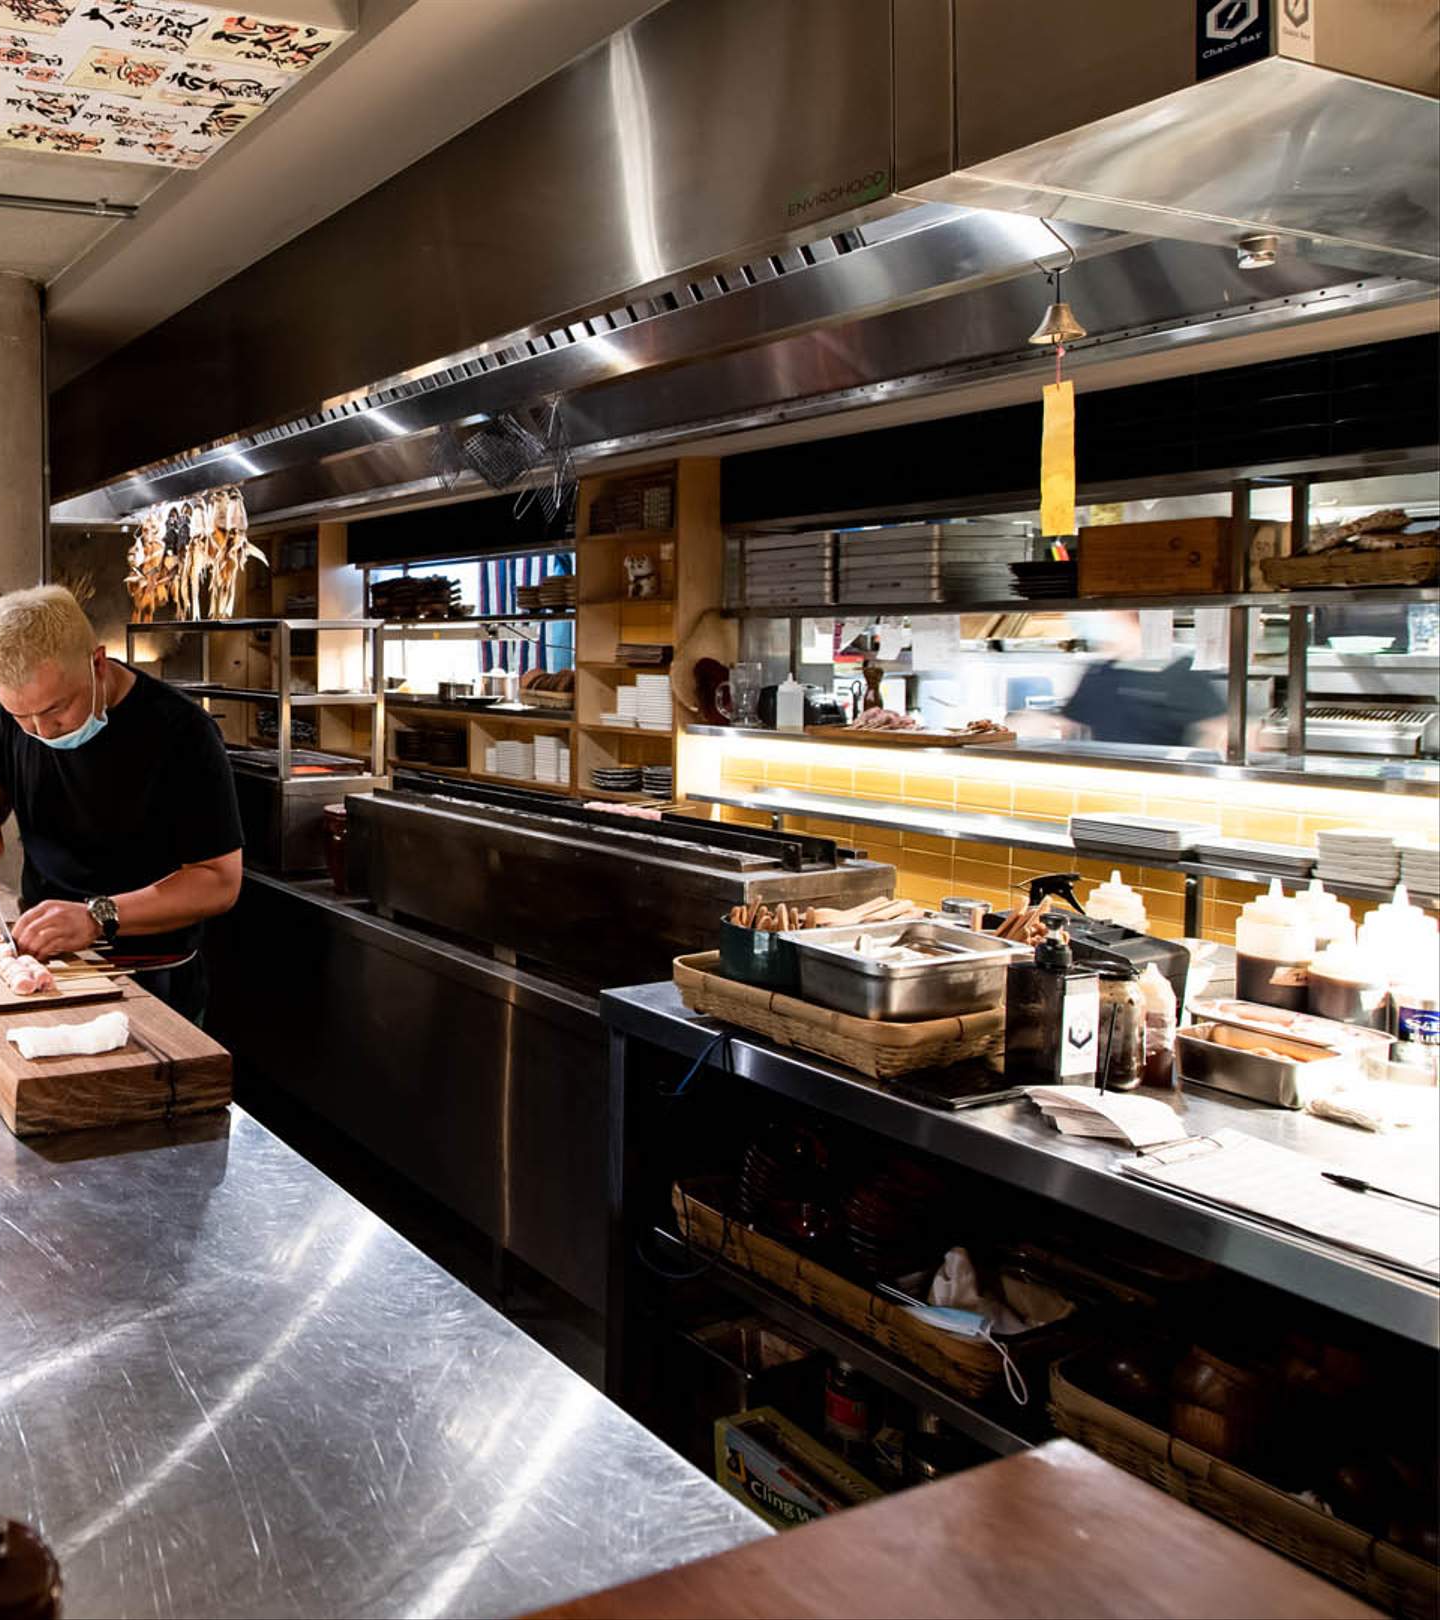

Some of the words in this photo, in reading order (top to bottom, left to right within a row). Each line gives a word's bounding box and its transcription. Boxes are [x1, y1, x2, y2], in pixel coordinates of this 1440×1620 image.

[1202, 41, 1239, 59] Chaco
[1240, 31, 1263, 45] Bar
[751, 1481, 795, 1519] Cling
